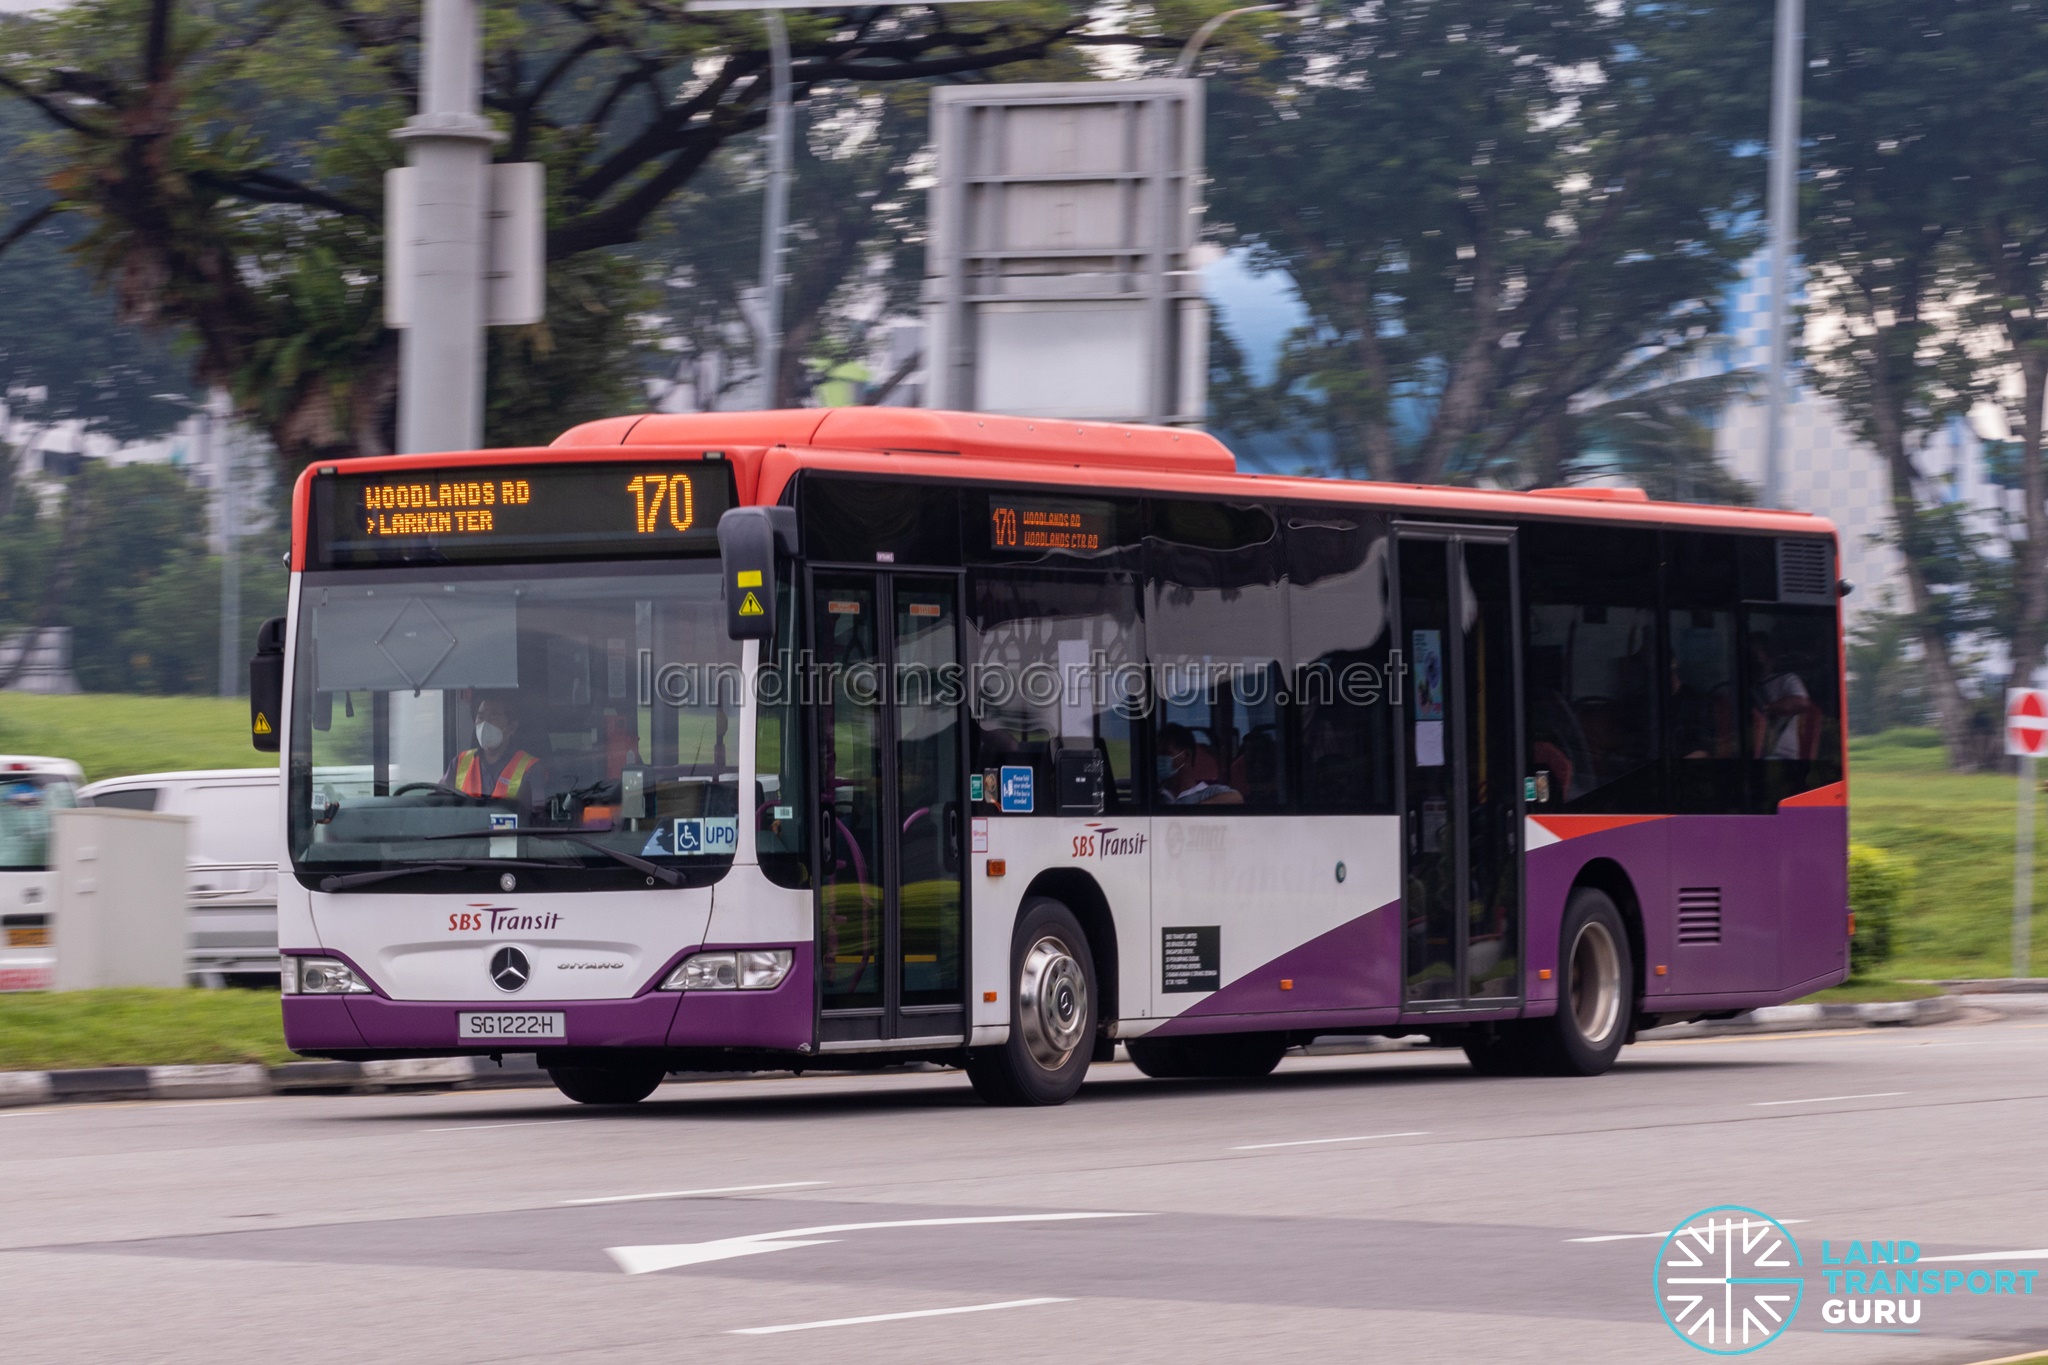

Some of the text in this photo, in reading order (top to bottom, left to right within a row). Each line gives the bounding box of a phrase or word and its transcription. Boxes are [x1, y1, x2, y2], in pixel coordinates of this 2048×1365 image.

[365, 480, 530, 509] WOODLANDS RD
[627, 473, 694, 533] 170
[454, 510, 493, 532] TER
[992, 507, 1016, 546] 170
[1023, 511, 1081, 527] WOODLANDS RD
[1024, 531, 1099, 549] WOODLANDS CTR RD
[705, 826, 735, 845] UPD
[1072, 828, 1148, 860] SBS Transit
[448, 907, 565, 934] SBS Transit
[470, 1016, 554, 1034] SG1222H
